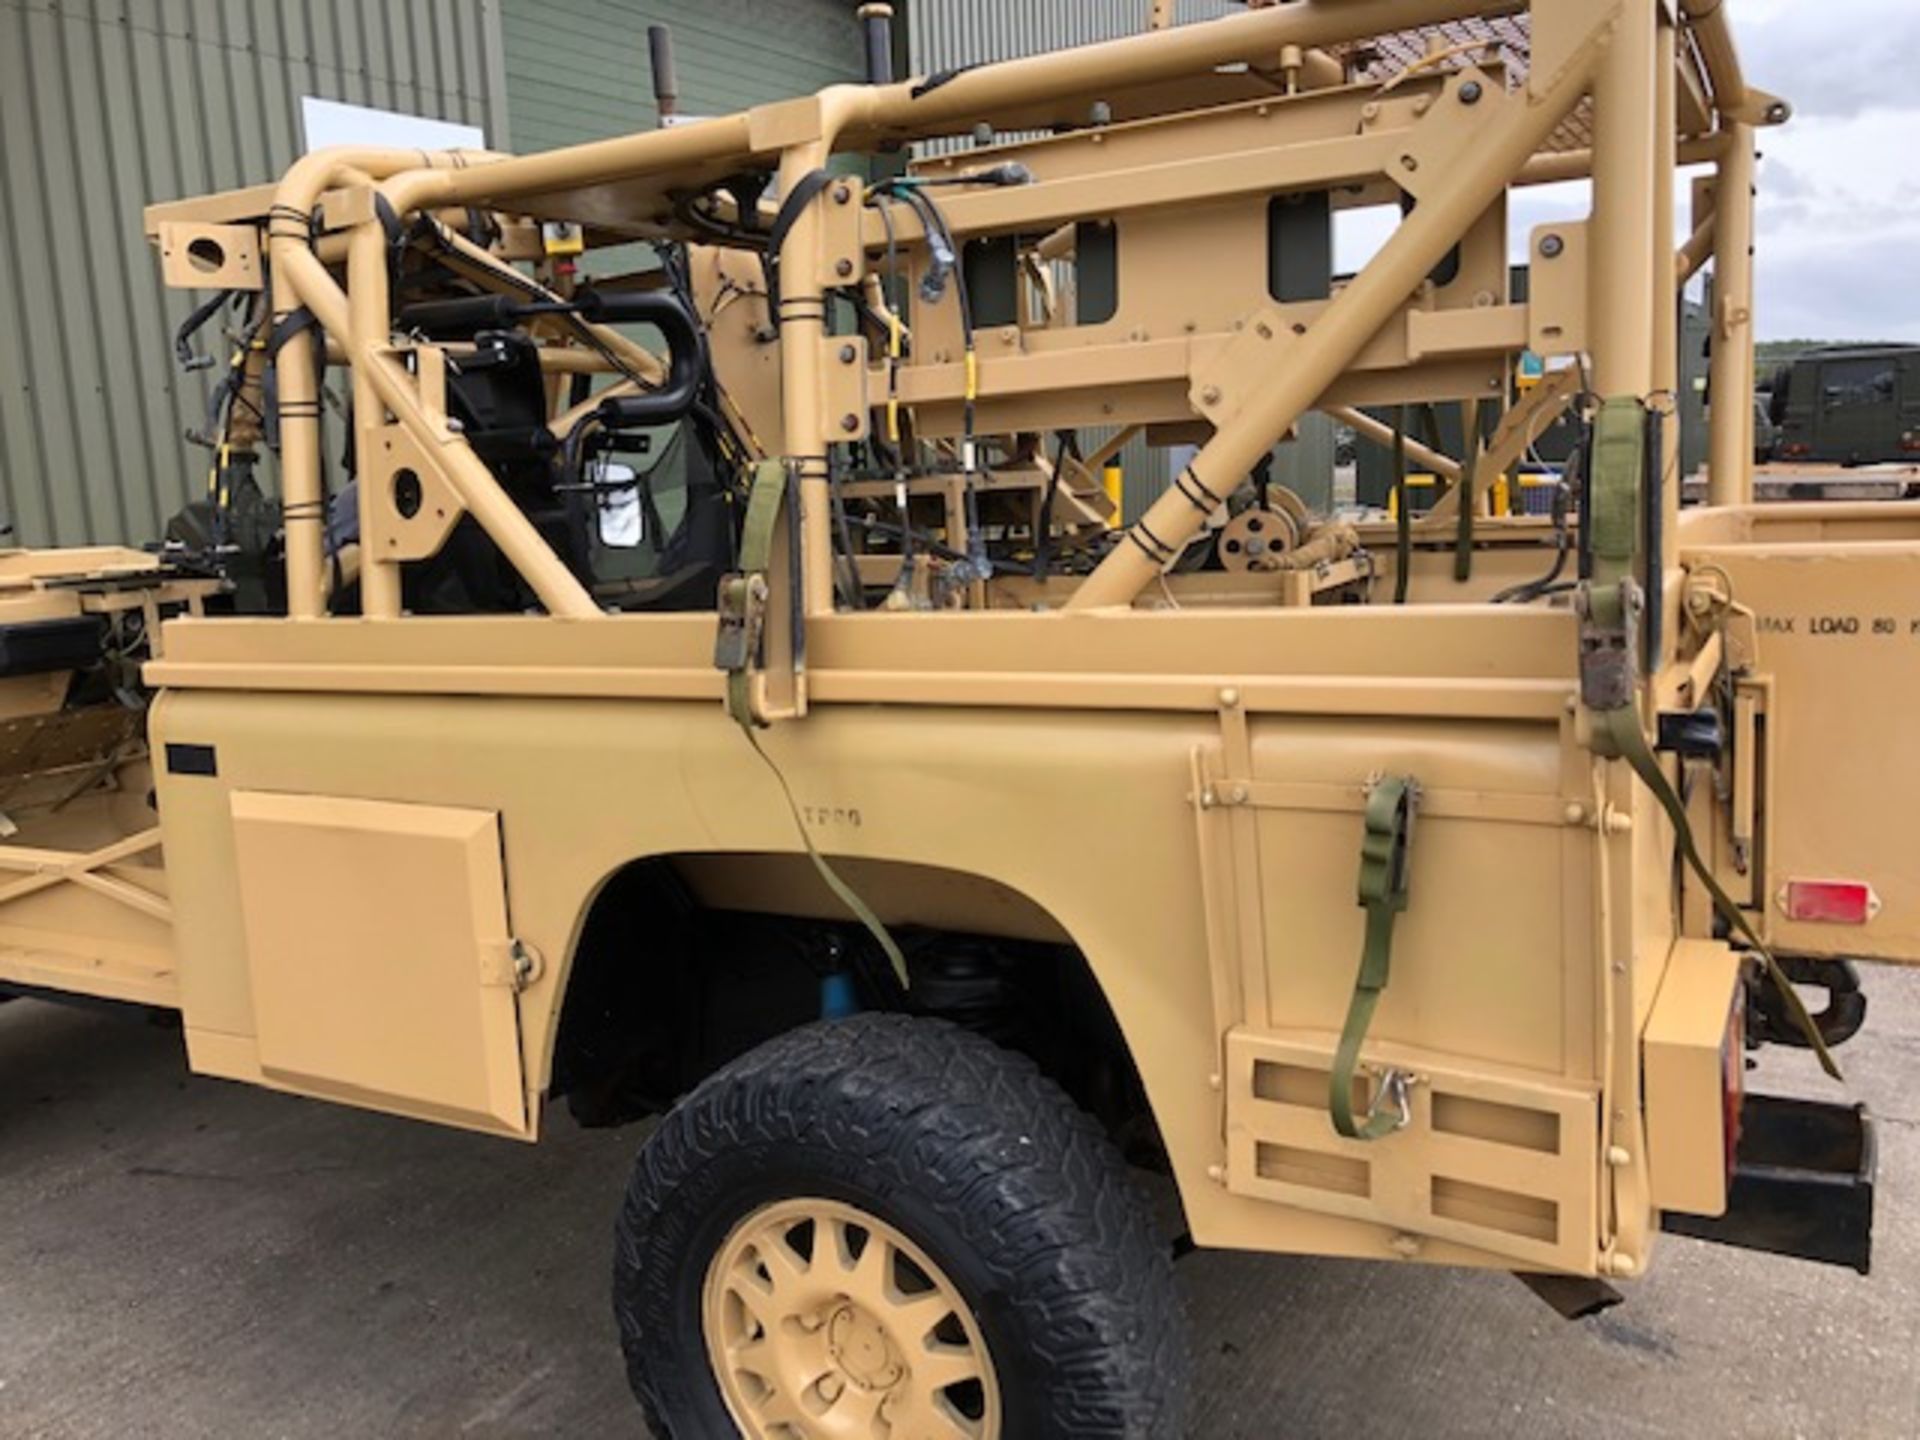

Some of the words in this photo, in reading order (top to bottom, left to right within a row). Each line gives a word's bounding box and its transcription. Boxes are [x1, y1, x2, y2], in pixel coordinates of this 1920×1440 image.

[1756, 616, 1795, 634] MAX
[1810, 617, 1859, 634] LOAD
[1872, 618, 1896, 634] 80
